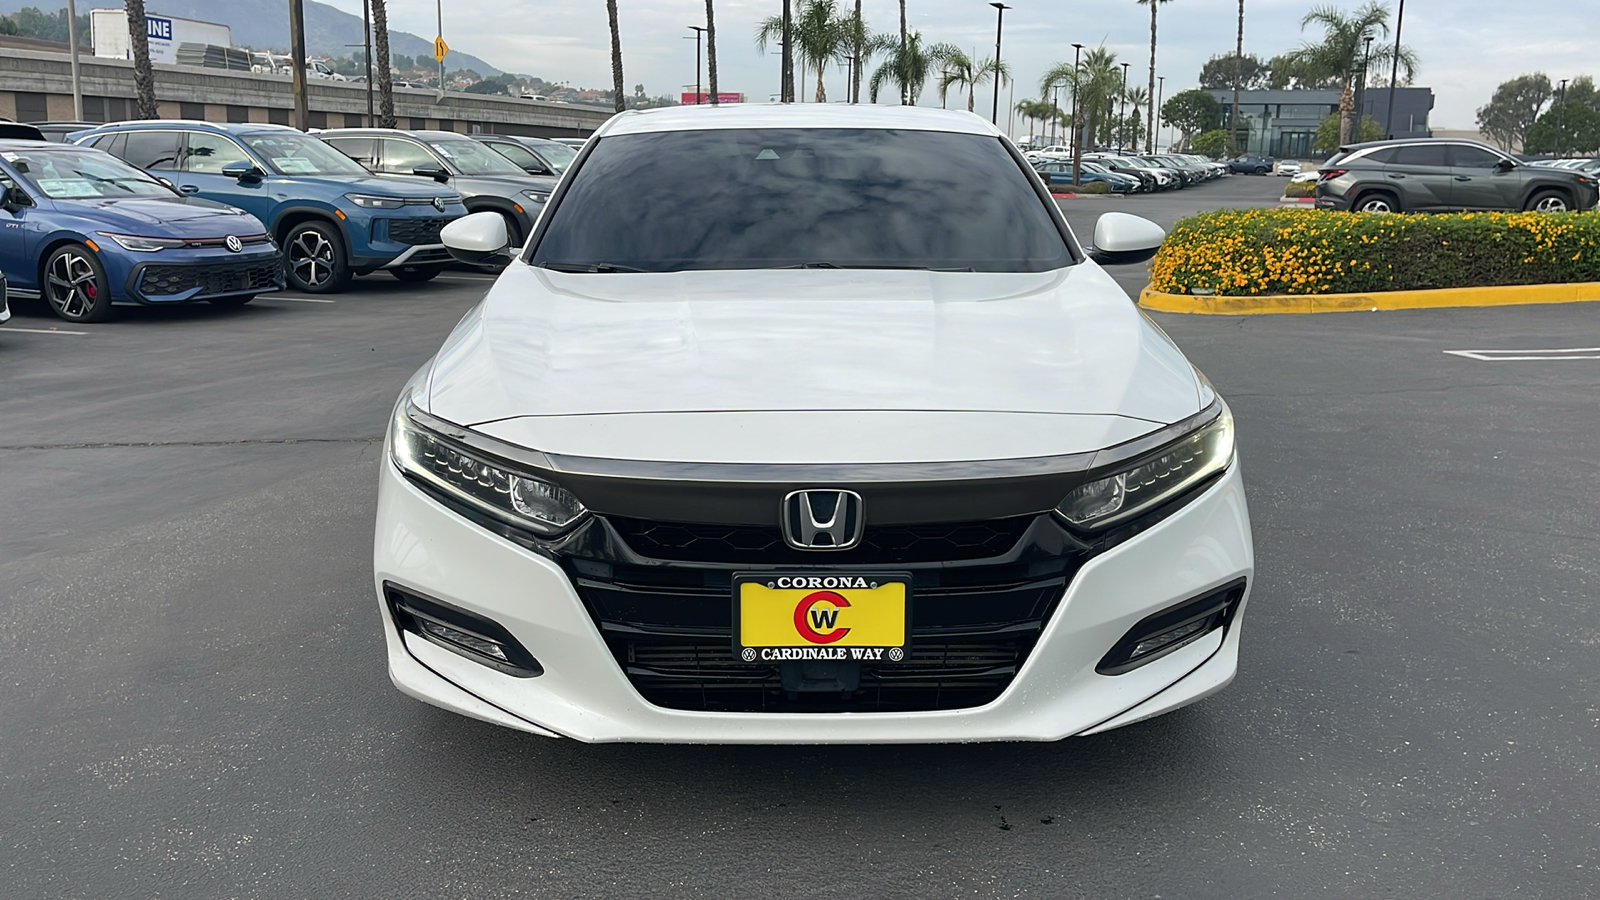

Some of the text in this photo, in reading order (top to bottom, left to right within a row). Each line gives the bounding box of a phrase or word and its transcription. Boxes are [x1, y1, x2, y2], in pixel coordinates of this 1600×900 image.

[777, 576, 868, 588] CORONA
[760, 648, 884, 660] CARDINALE WAY
